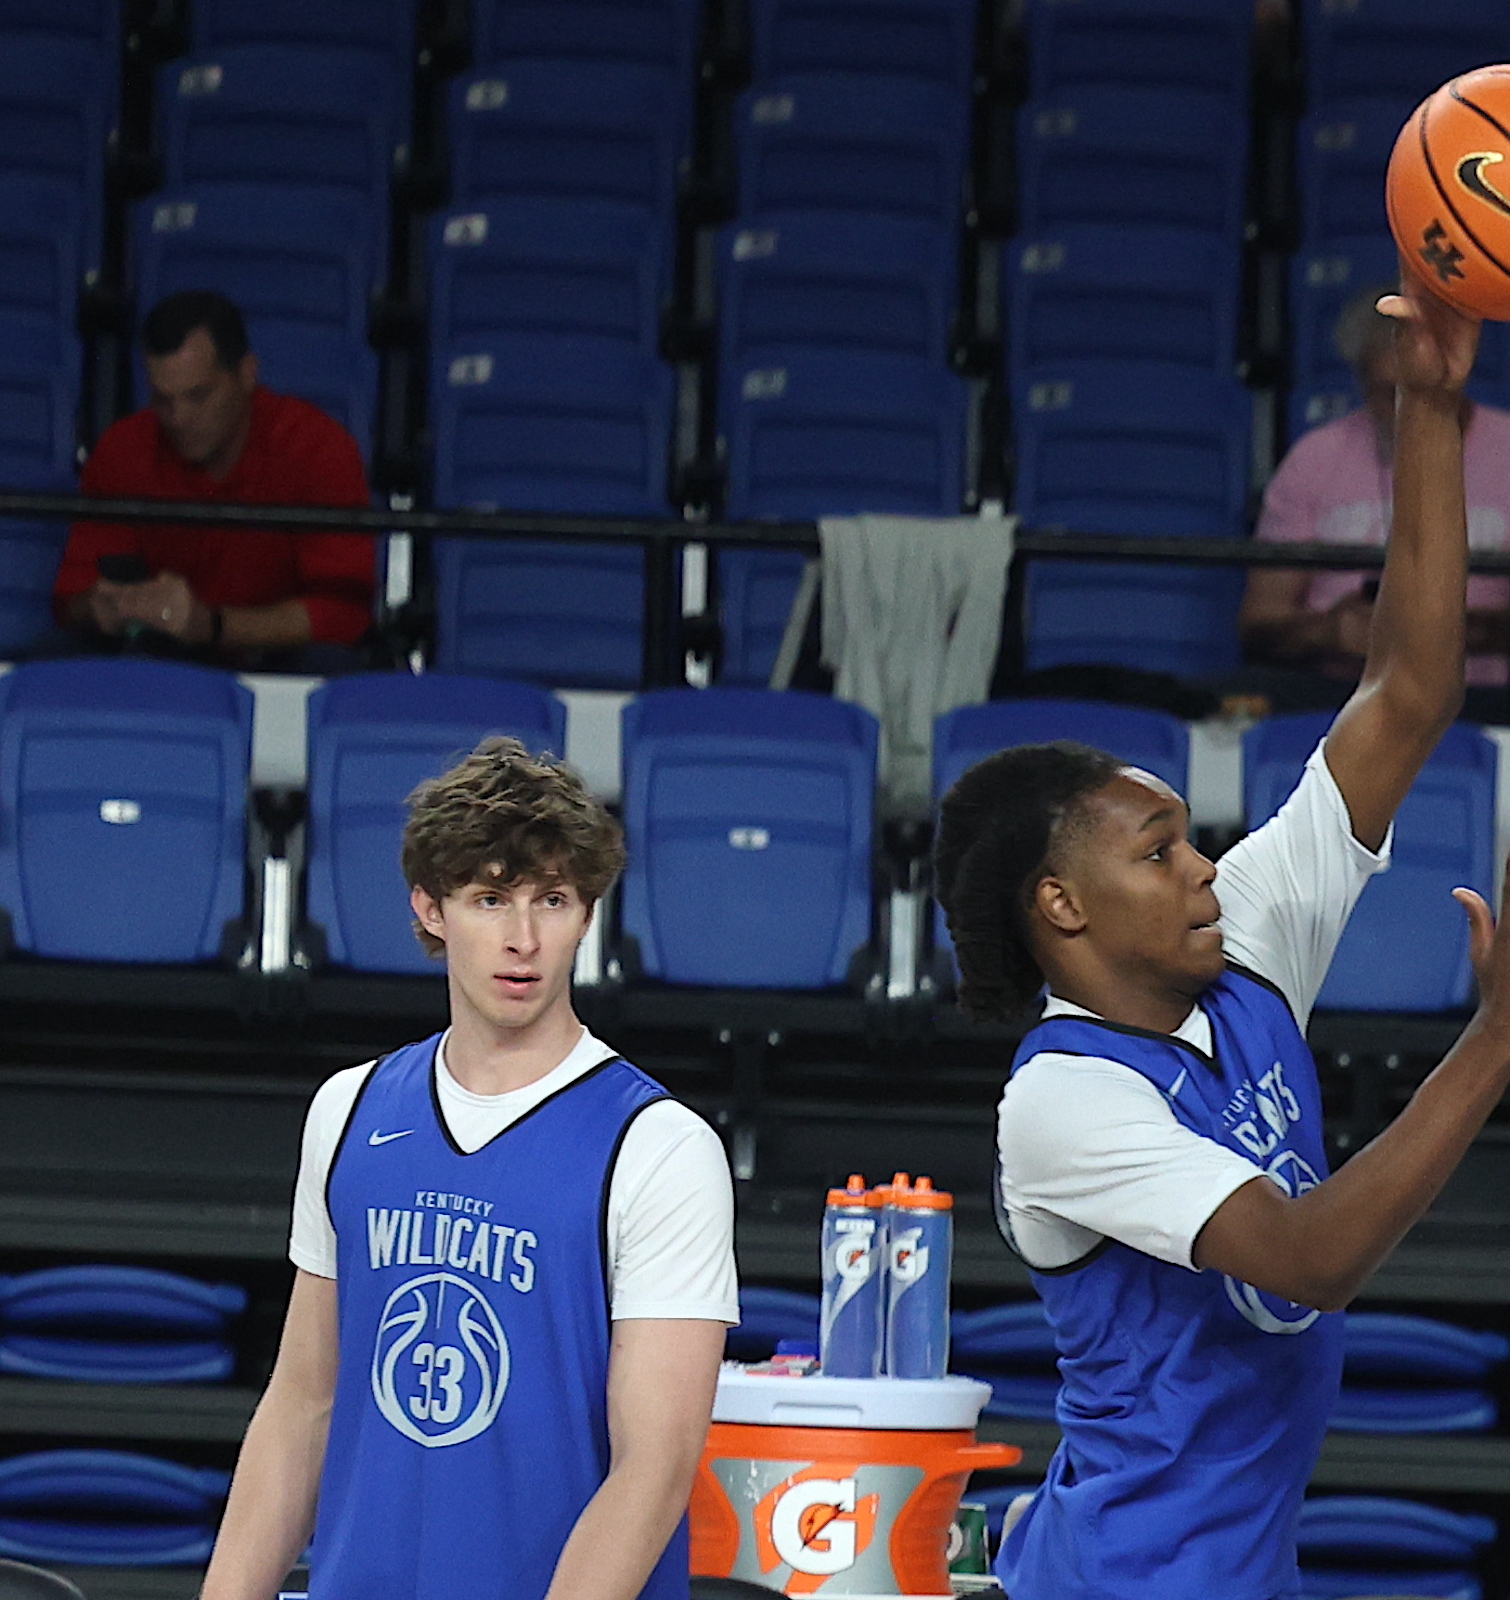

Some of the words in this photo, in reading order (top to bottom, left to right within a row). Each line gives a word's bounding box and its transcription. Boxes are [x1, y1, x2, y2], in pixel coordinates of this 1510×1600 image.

[1419, 218, 1465, 284] UK
[415, 1190, 494, 1217] KENTUCKY
[367, 1208, 538, 1294] WILDCATS
[409, 1343, 465, 1424] 33
[772, 1478, 857, 1575] G
